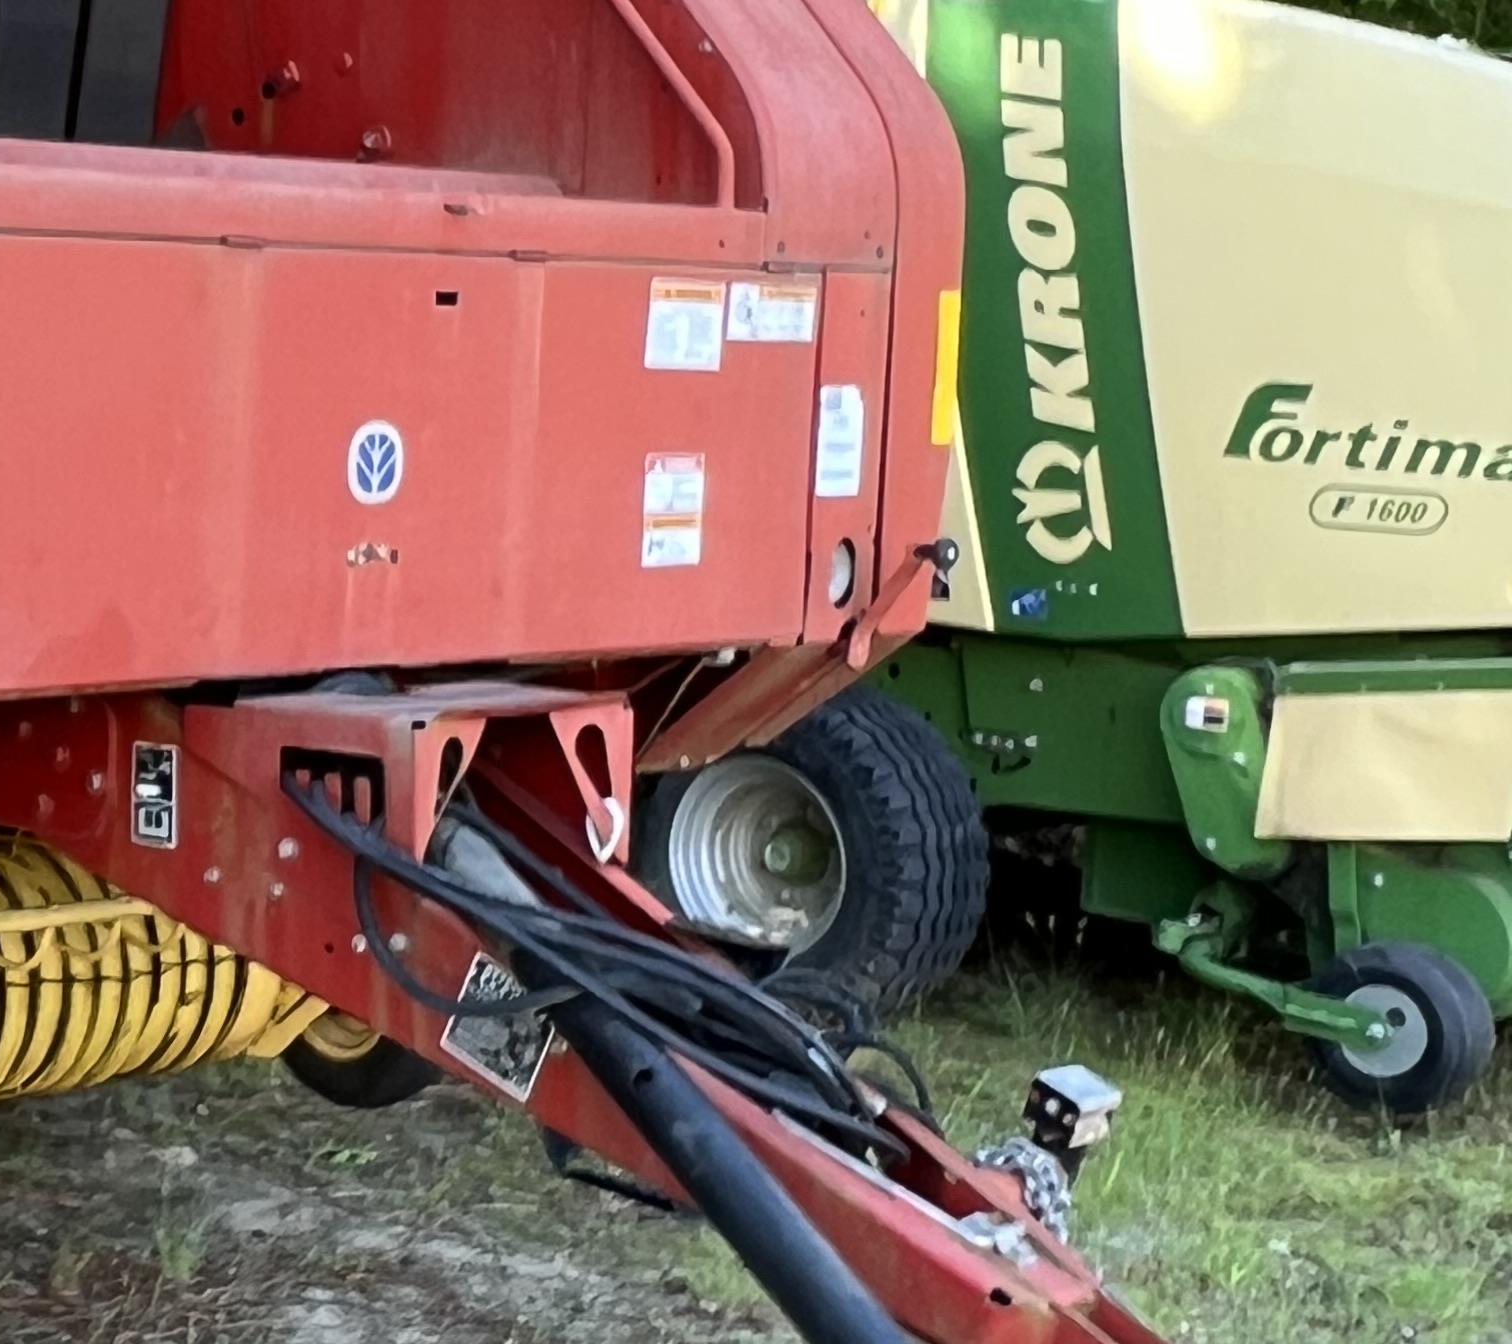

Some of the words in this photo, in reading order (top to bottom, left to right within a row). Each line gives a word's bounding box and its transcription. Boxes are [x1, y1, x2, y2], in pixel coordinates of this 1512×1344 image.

[1000, 32, 1096, 434] KRONE
[1332, 495, 1355, 519] F
[1366, 498, 1429, 524] 1600
